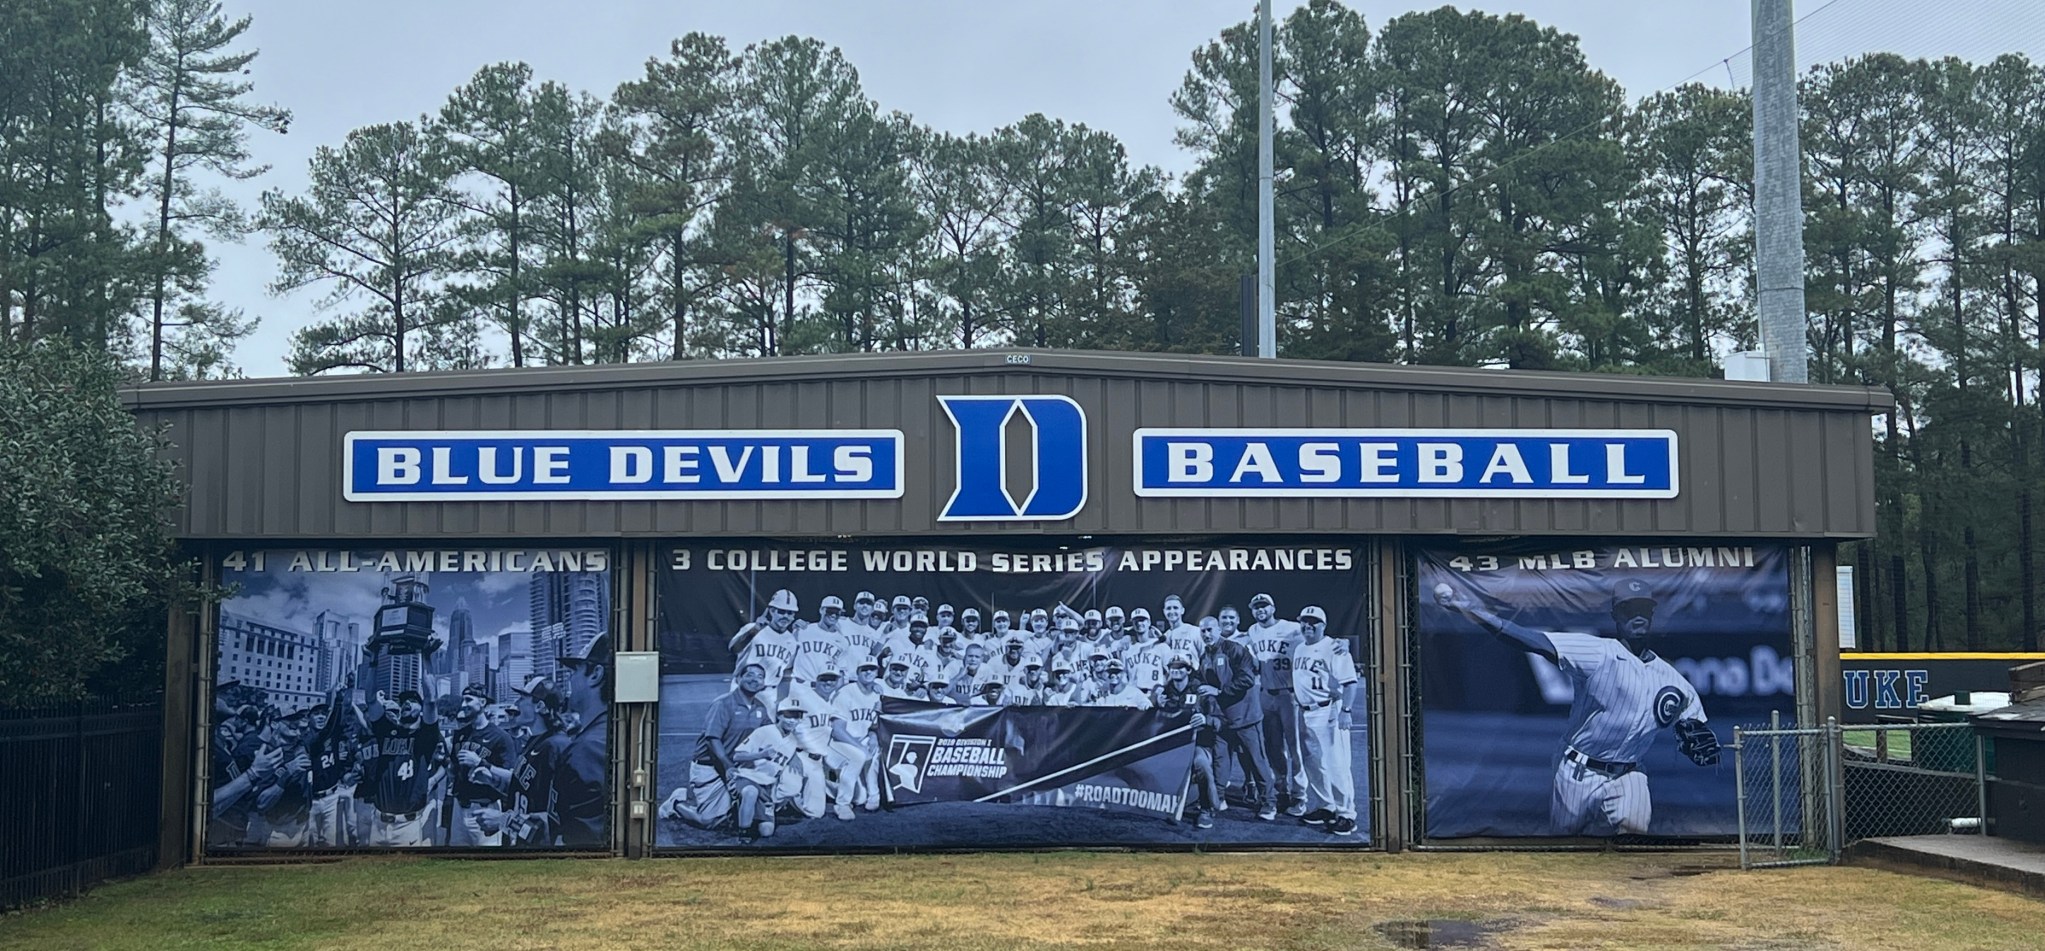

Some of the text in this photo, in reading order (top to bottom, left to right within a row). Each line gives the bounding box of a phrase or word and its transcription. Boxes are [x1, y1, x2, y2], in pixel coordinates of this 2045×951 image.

[1006, 354, 1029, 364] CECO
[376, 445, 873, 485] BLUE DEVILS
[1167, 442, 1646, 484] BASEBALL
[222, 550, 608, 572] 41 ALL-AMERICANS
[672, 549, 1353, 573] 3 COLLEGE WORLD SERIES APPEARANCES
[1449, 547, 1755, 572] 43 MLB ALUMNI
[1273, 657, 1291, 671] 39
[1843, 670, 1929, 709] UKE
[931, 746, 1005, 765] BASEBALL
[926, 764, 1008, 779] CHAMPIONSHIP
